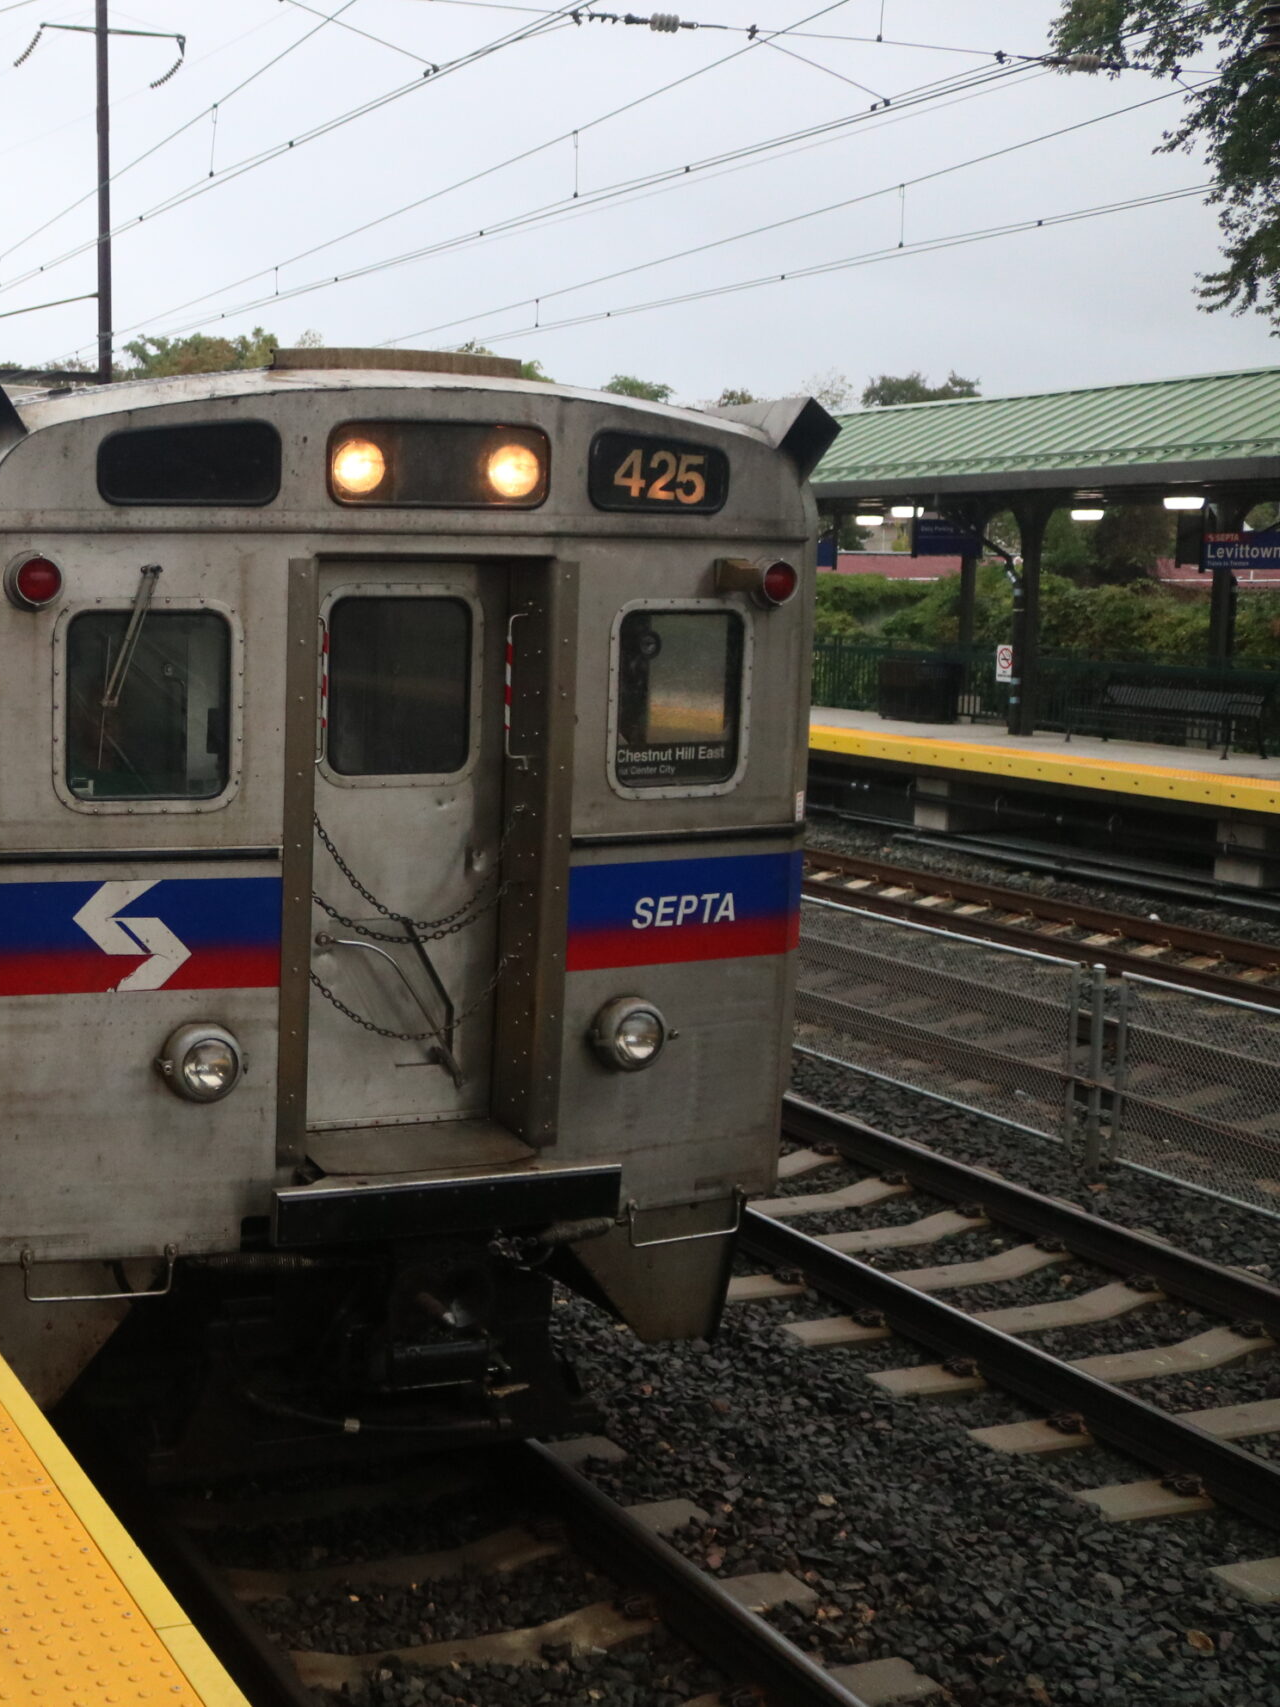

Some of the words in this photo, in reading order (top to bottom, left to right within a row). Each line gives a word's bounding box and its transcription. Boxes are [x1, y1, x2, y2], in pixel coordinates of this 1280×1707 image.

[613, 449, 706, 505] 425
[1207, 544, 1280, 559] Levittown
[617, 748, 673, 764] Chestnut
[675, 746, 695, 760] Hill
[698, 746, 725, 760] East
[630, 766, 657, 775] Center
[659, 764, 676, 775] City
[632, 892, 735, 929] SEPTA
